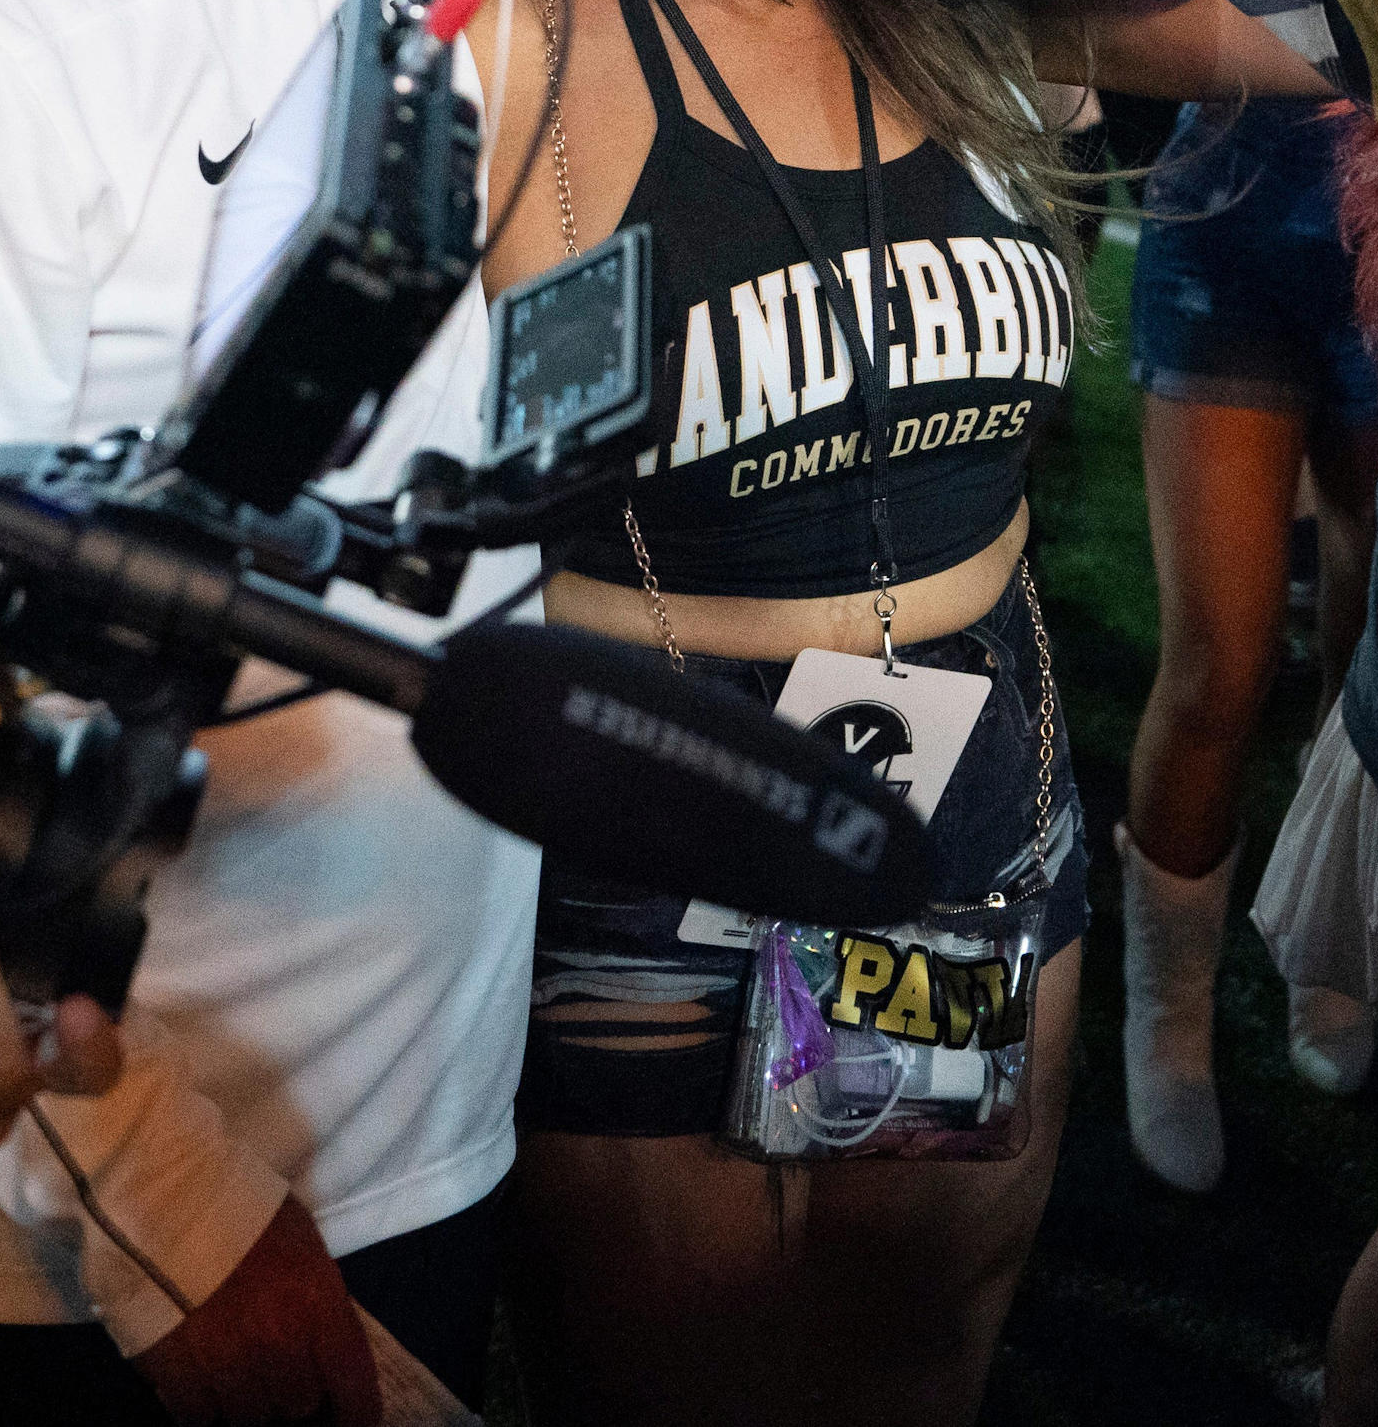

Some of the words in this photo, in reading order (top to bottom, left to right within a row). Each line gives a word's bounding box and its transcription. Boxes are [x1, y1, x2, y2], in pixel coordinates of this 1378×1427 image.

[635, 236, 1074, 478] ANDERBIL
[729, 399, 1032, 499] COMMDORES
[844, 723, 880, 755] V
